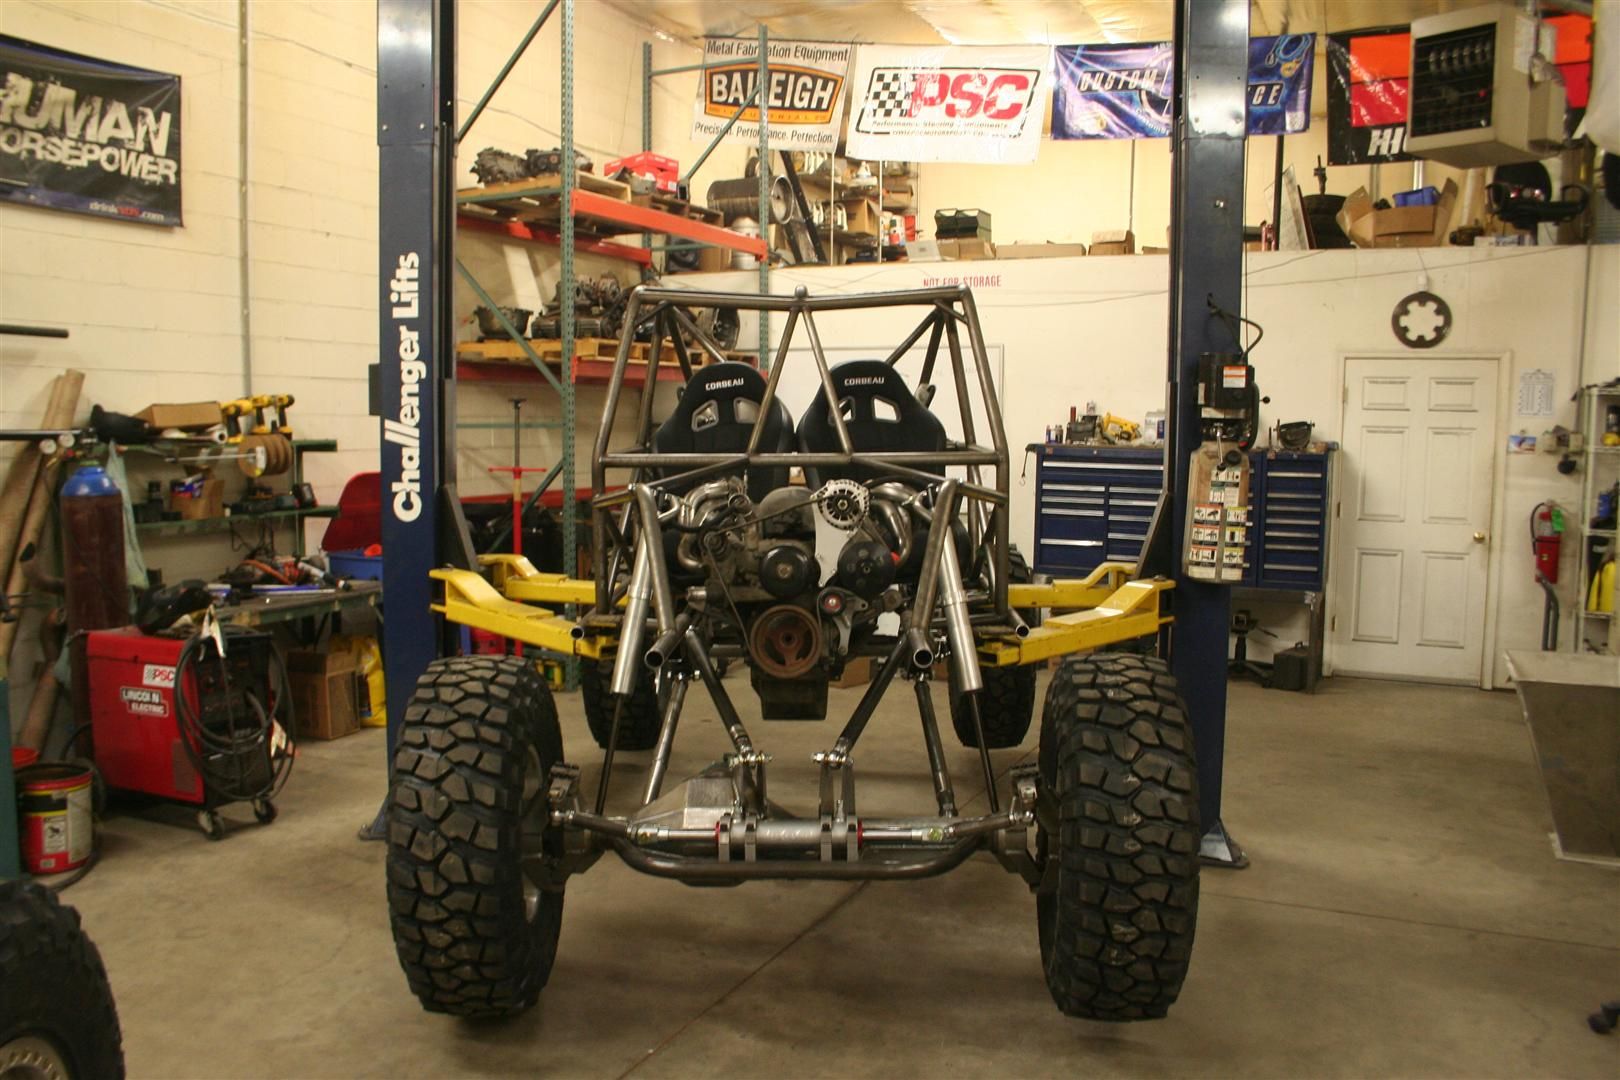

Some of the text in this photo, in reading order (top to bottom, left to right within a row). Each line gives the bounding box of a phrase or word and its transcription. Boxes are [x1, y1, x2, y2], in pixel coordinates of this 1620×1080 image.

[707, 40, 849, 62] Metal Fabration Equipment
[1080, 69, 1158, 92] CUSTOM
[907, 73, 1029, 119] PSC
[0, 122, 178, 185] ORSEPOWER
[923, 274, 1002, 288] NOT FOR STORAGE
[384, 252, 427, 523] Challenger Lifts
[705, 377, 744, 391] CORBEAU
[844, 376, 885, 387] CORBEAU
[153, 668, 175, 682] PSC
